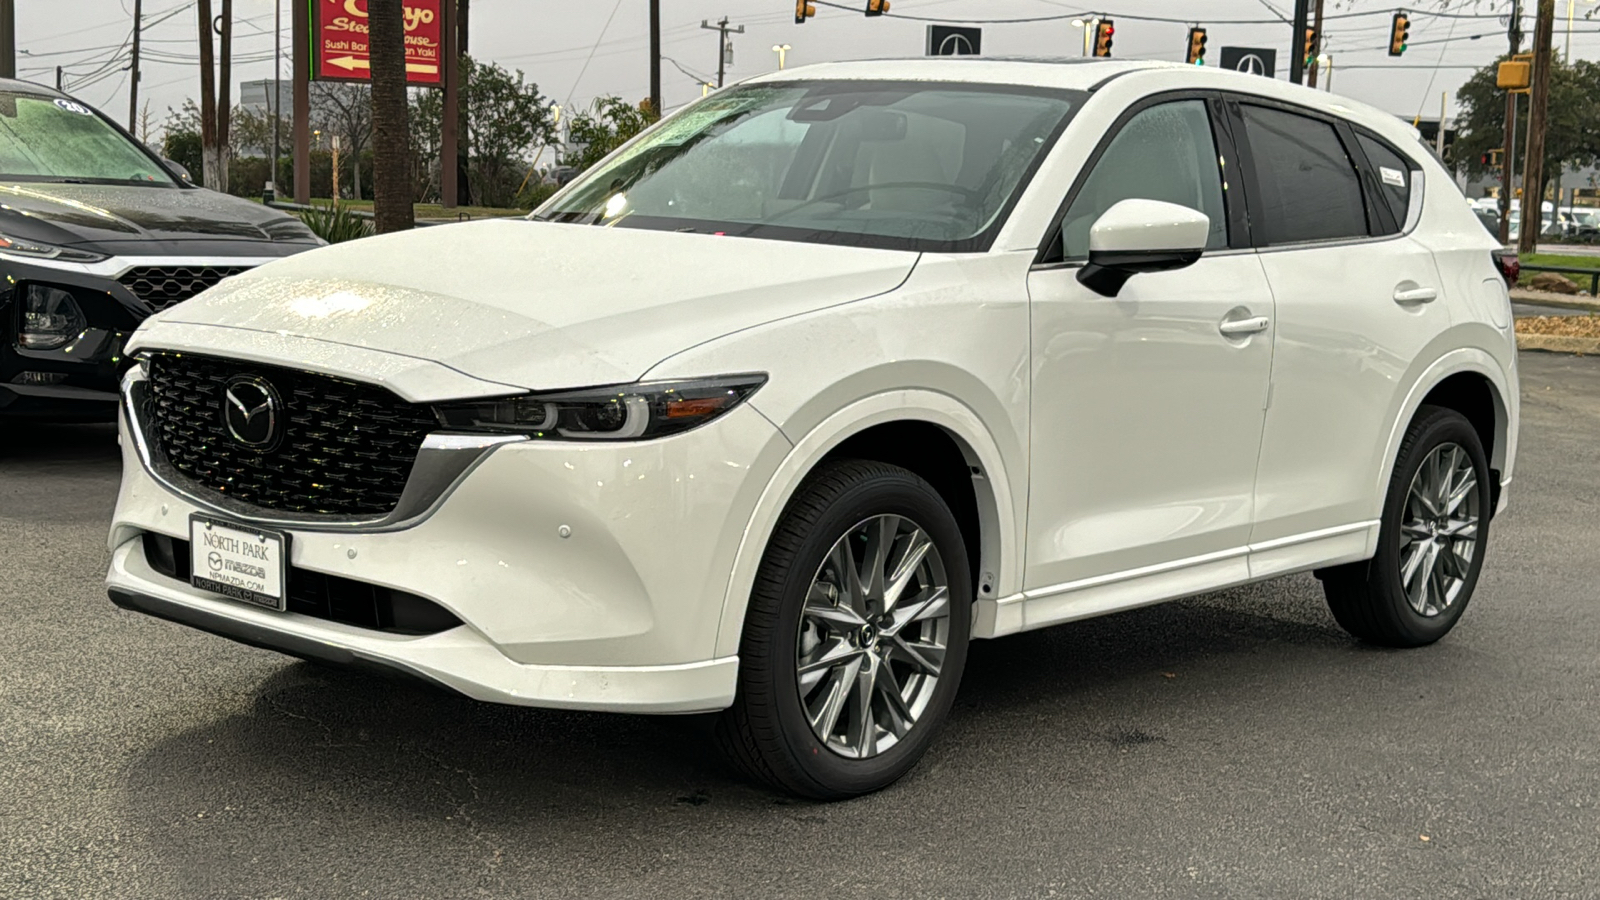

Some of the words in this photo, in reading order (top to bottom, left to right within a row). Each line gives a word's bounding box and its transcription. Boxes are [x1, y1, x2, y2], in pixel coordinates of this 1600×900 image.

[325, 39, 349, 50] Sushi
[351, 41, 367, 51] Bar
[417, 47, 436, 57] Yaki
[403, 33, 438, 47] ouse
[61, 100, 84, 113] 20
[203, 532, 239, 554] NORTH
[242, 541, 269, 561] PARK
[195, 577, 221, 592] NORTH
[222, 584, 243, 599] PARK
